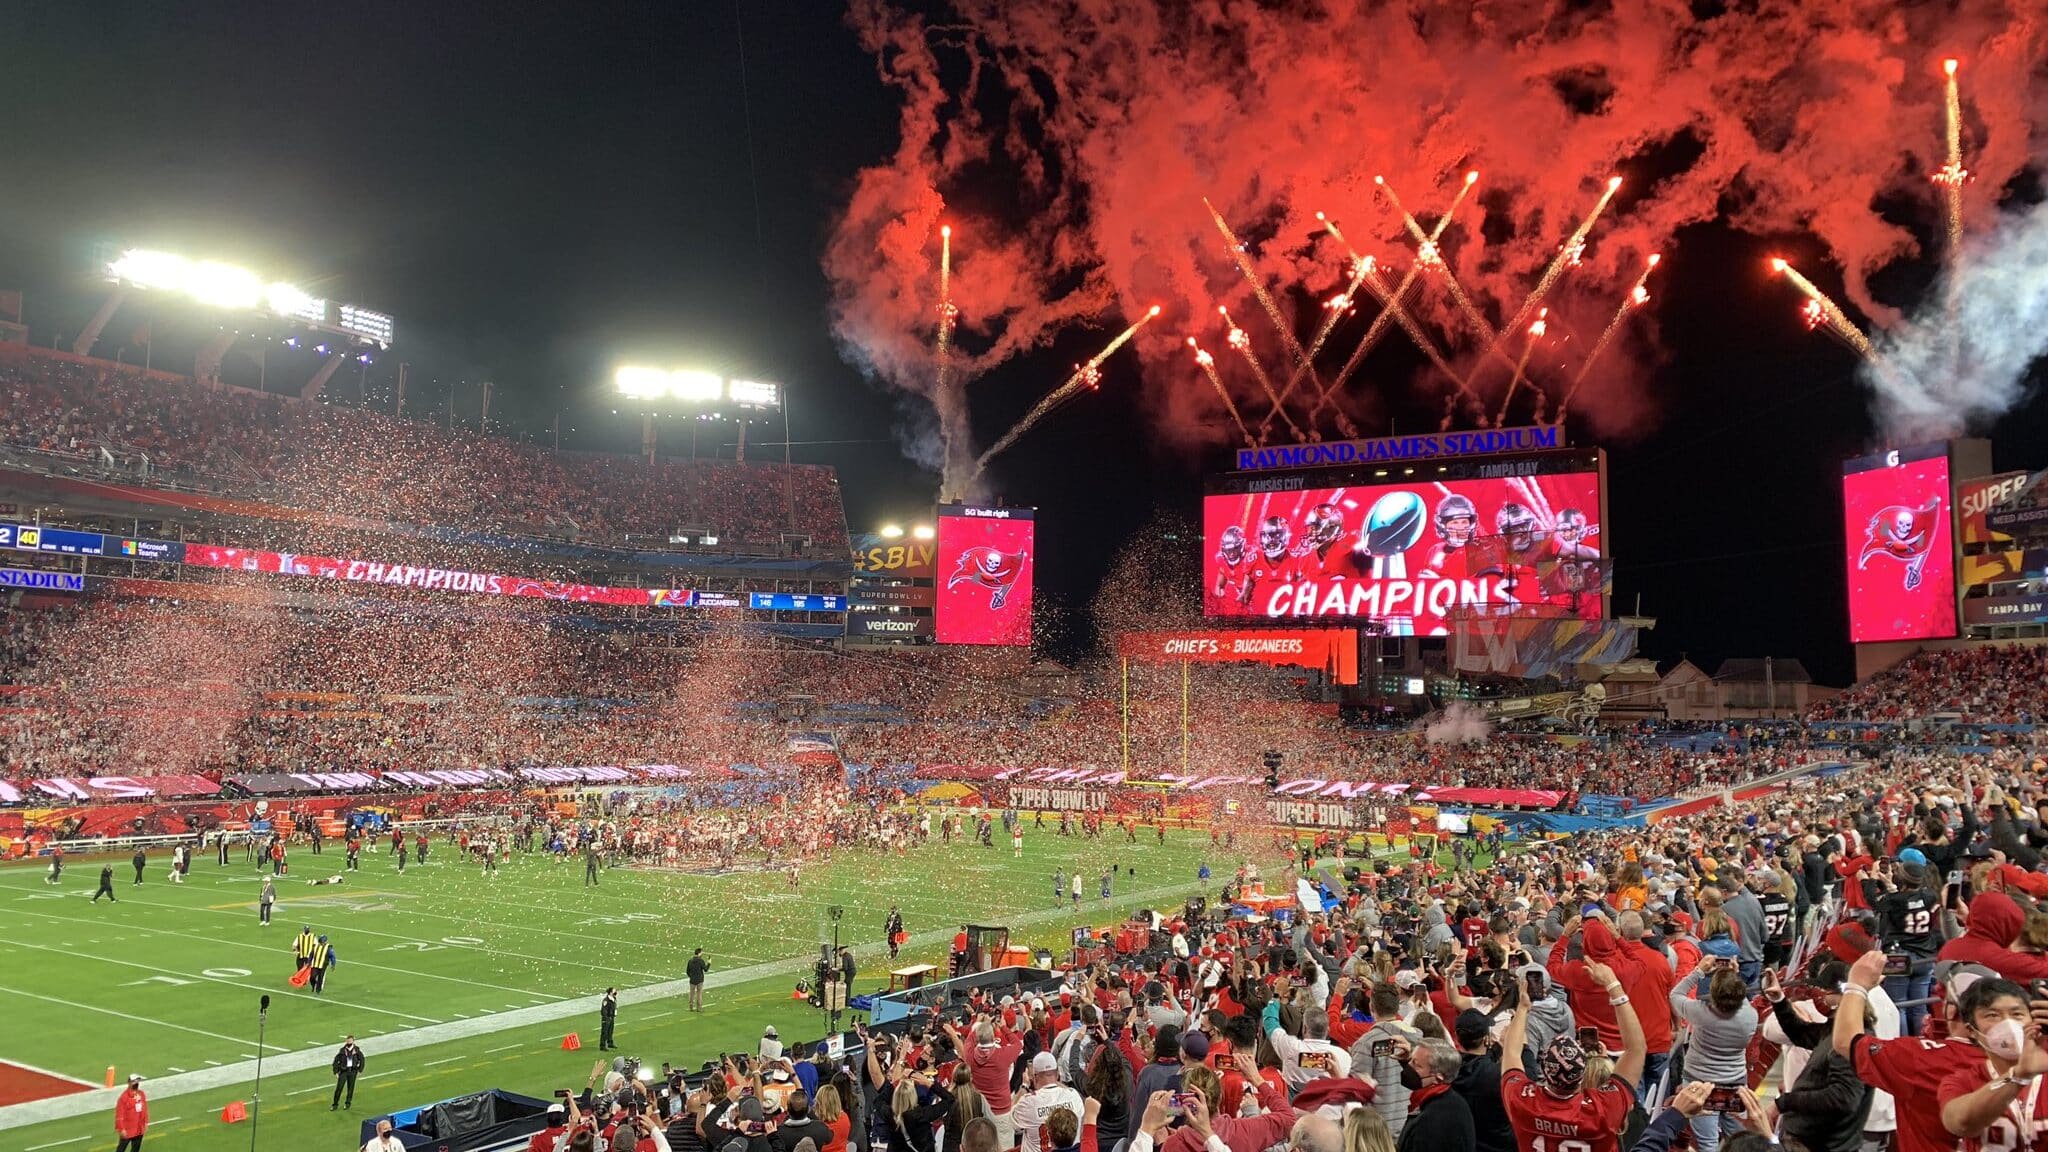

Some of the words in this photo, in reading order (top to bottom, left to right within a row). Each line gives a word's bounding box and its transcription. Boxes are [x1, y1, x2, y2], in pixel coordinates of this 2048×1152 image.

[1240, 442, 1355, 470] RAYMOND
[1359, 436, 1438, 462] JAMES
[1443, 427, 1557, 454] STADIUM
[1479, 463, 1515, 478] TAMPA
[1517, 462, 1538, 476] BAY
[1249, 479, 1283, 492] KANSAS
[1285, 478, 1304, 490] CITY
[1962, 474, 2028, 518] SUPER
[965, 508, 976, 516] 5G
[977, 509, 992, 517] built
[992, 510, 1010, 518] right
[19, 531, 38, 545] 40
[138, 541, 168, 552] Microsoft
[138, 550, 158, 558] Teams
[0, 571, 82, 590] STADIUM
[347, 560, 501, 594] CHAMPIONS
[861, 591, 886, 599] SUPER
[889, 592, 910, 600] BOWL
[1266, 577, 1522, 617] CHAMPIONS
[1988, 606, 2019, 615] TAMPA
[2023, 603, 2042, 612] BAY
[866, 619, 914, 631] verizon
[1165, 639, 1218, 654] CHIEFS
[1234, 639, 1303, 654] BUCCANEERS
[1009, 787, 1050, 808] SUPER
[1052, 790, 1088, 810] BOWL
[1905, 911, 1930, 934] 12
[1534, 1117, 1579, 1137] BRADY
